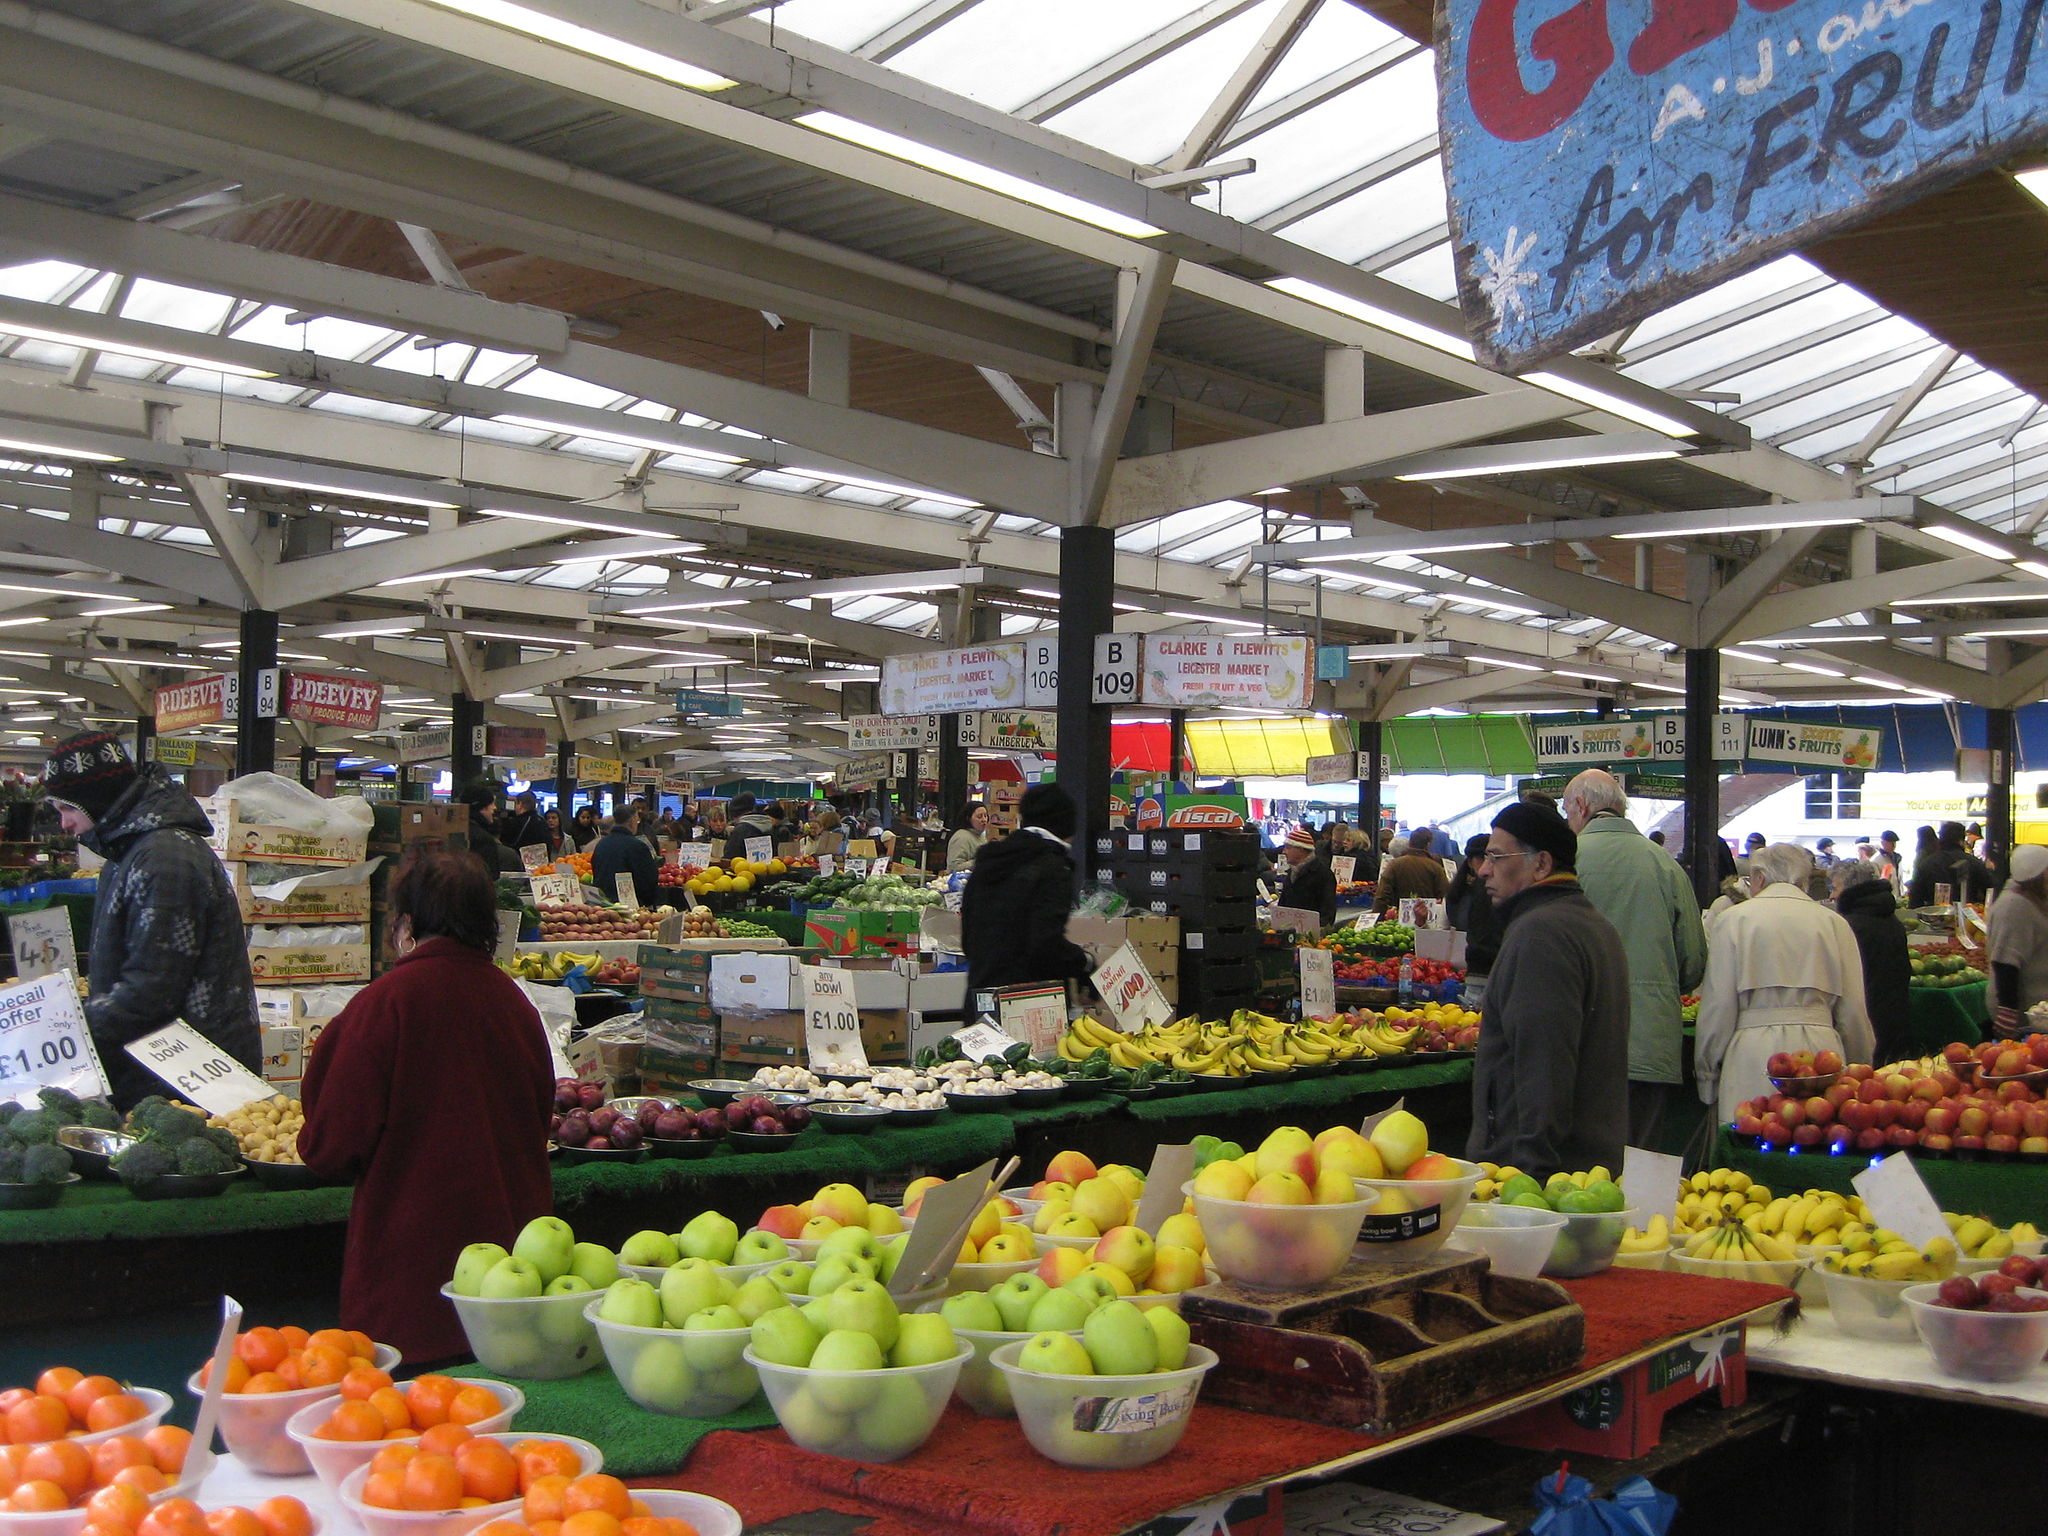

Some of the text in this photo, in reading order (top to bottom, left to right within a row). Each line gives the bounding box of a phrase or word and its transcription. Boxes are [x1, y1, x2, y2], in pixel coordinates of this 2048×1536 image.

[1108, 642, 1122, 663] B
[1160, 641, 1289, 656] CLARKE & FLEWITTS
[1038, 648, 1049, 665] B
[1178, 662, 1270, 676] LEICESTER MARKET
[230, 678, 237, 692] B
[265, 675, 272, 690] B
[1030, 670, 1058, 688] 106
[1094, 672, 1135, 695] 109
[1182, 682, 1204, 691] FRESH
[1209, 682, 1235, 691] FRUIT
[1247, 683, 1262, 692] VEG
[260, 697, 273, 712] 94
[928, 715, 936, 727] B
[965, 715, 973, 726] B
[991, 712, 1011, 724] MICK
[1665, 721, 1676, 735] B
[1722, 723, 1731, 734] B
[926, 731, 938, 743] 91
[961, 731, 976, 743] 96
[989, 735, 1036, 748] KIMBERLEY
[1582, 740, 1622, 754] FRUITS
[1656, 739, 1685, 754] 105
[1721, 740, 1739, 751] 111
[1799, 739, 1842, 755] FRUITS
[1944, 801, 1963, 812] got
[1174, 808, 1240, 824] Tiscar
[818, 971, 834, 982] any
[814, 980, 843, 995] bowl
[0, 1005, 43, 1029] offer
[813, 1010, 855, 1031] £1.00
[54, 1019, 73, 1030] only
[149, 1036, 169, 1049] any
[149, 1039, 189, 1063] bowl
[177, 1058, 233, 1093] £1.00
